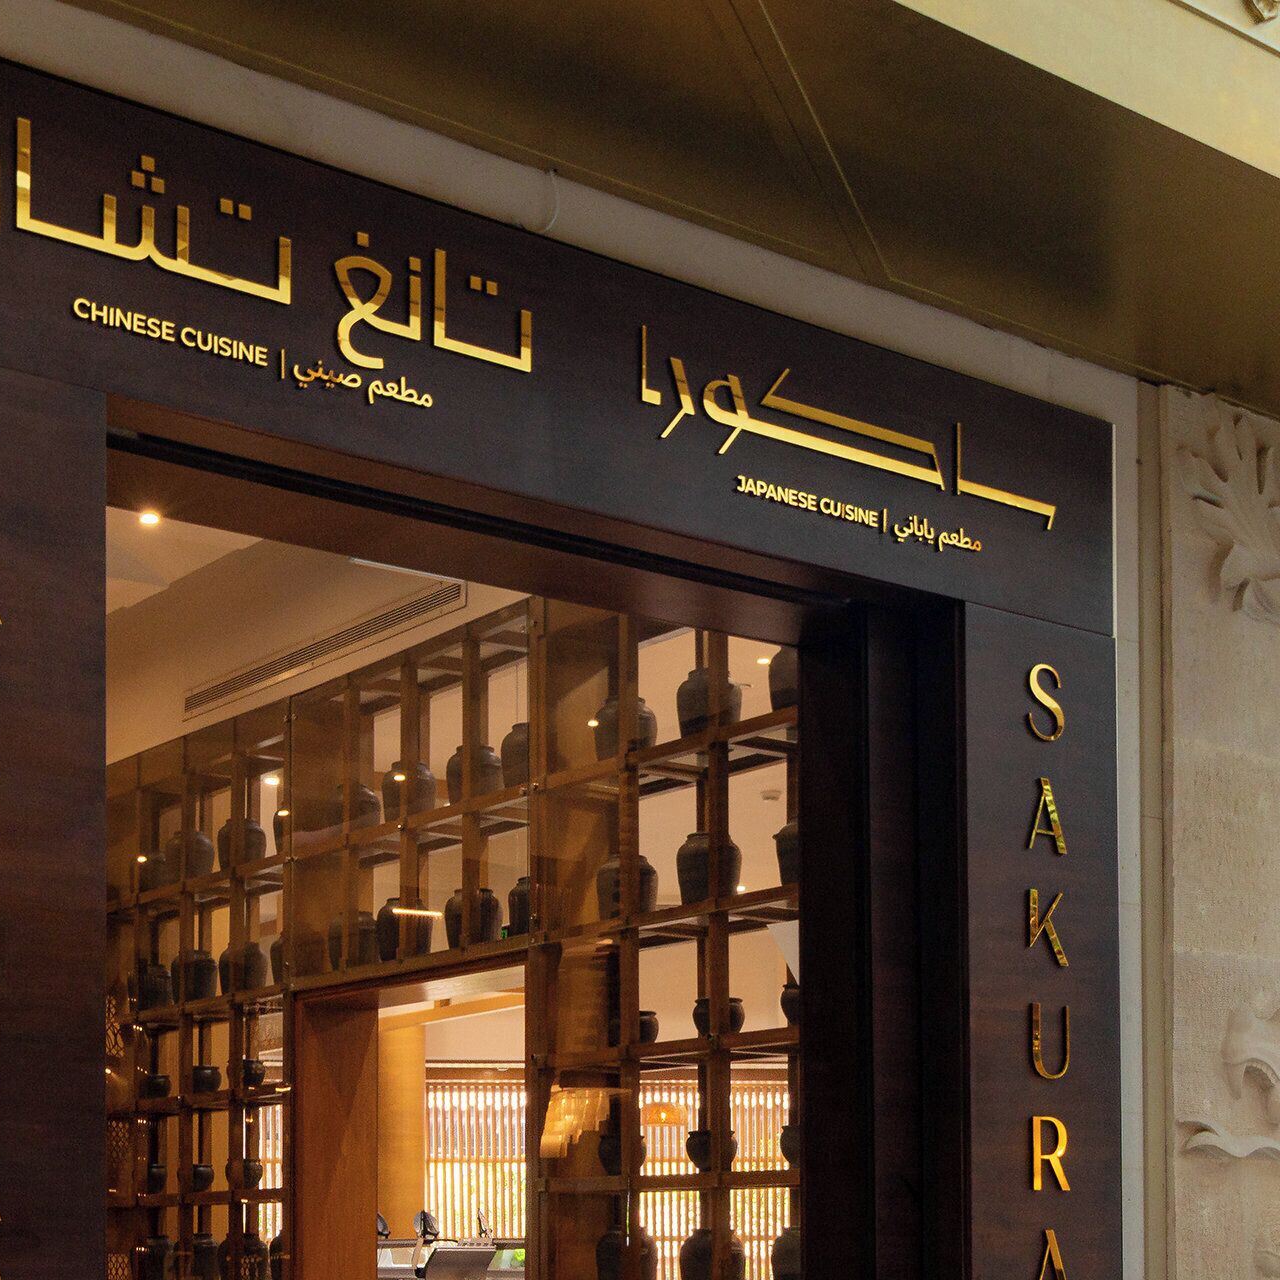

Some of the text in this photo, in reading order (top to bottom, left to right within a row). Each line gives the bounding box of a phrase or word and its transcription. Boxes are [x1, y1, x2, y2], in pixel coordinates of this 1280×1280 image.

[334, 232, 532, 373] تانغ
[73, 298, 269, 367] CHINESE CUISINE
[293, 360, 433, 408] مطعم صيني
[736, 475, 879, 528] JAPANESE CUISINE
[894, 515, 982, 552] مطعم ياباني
